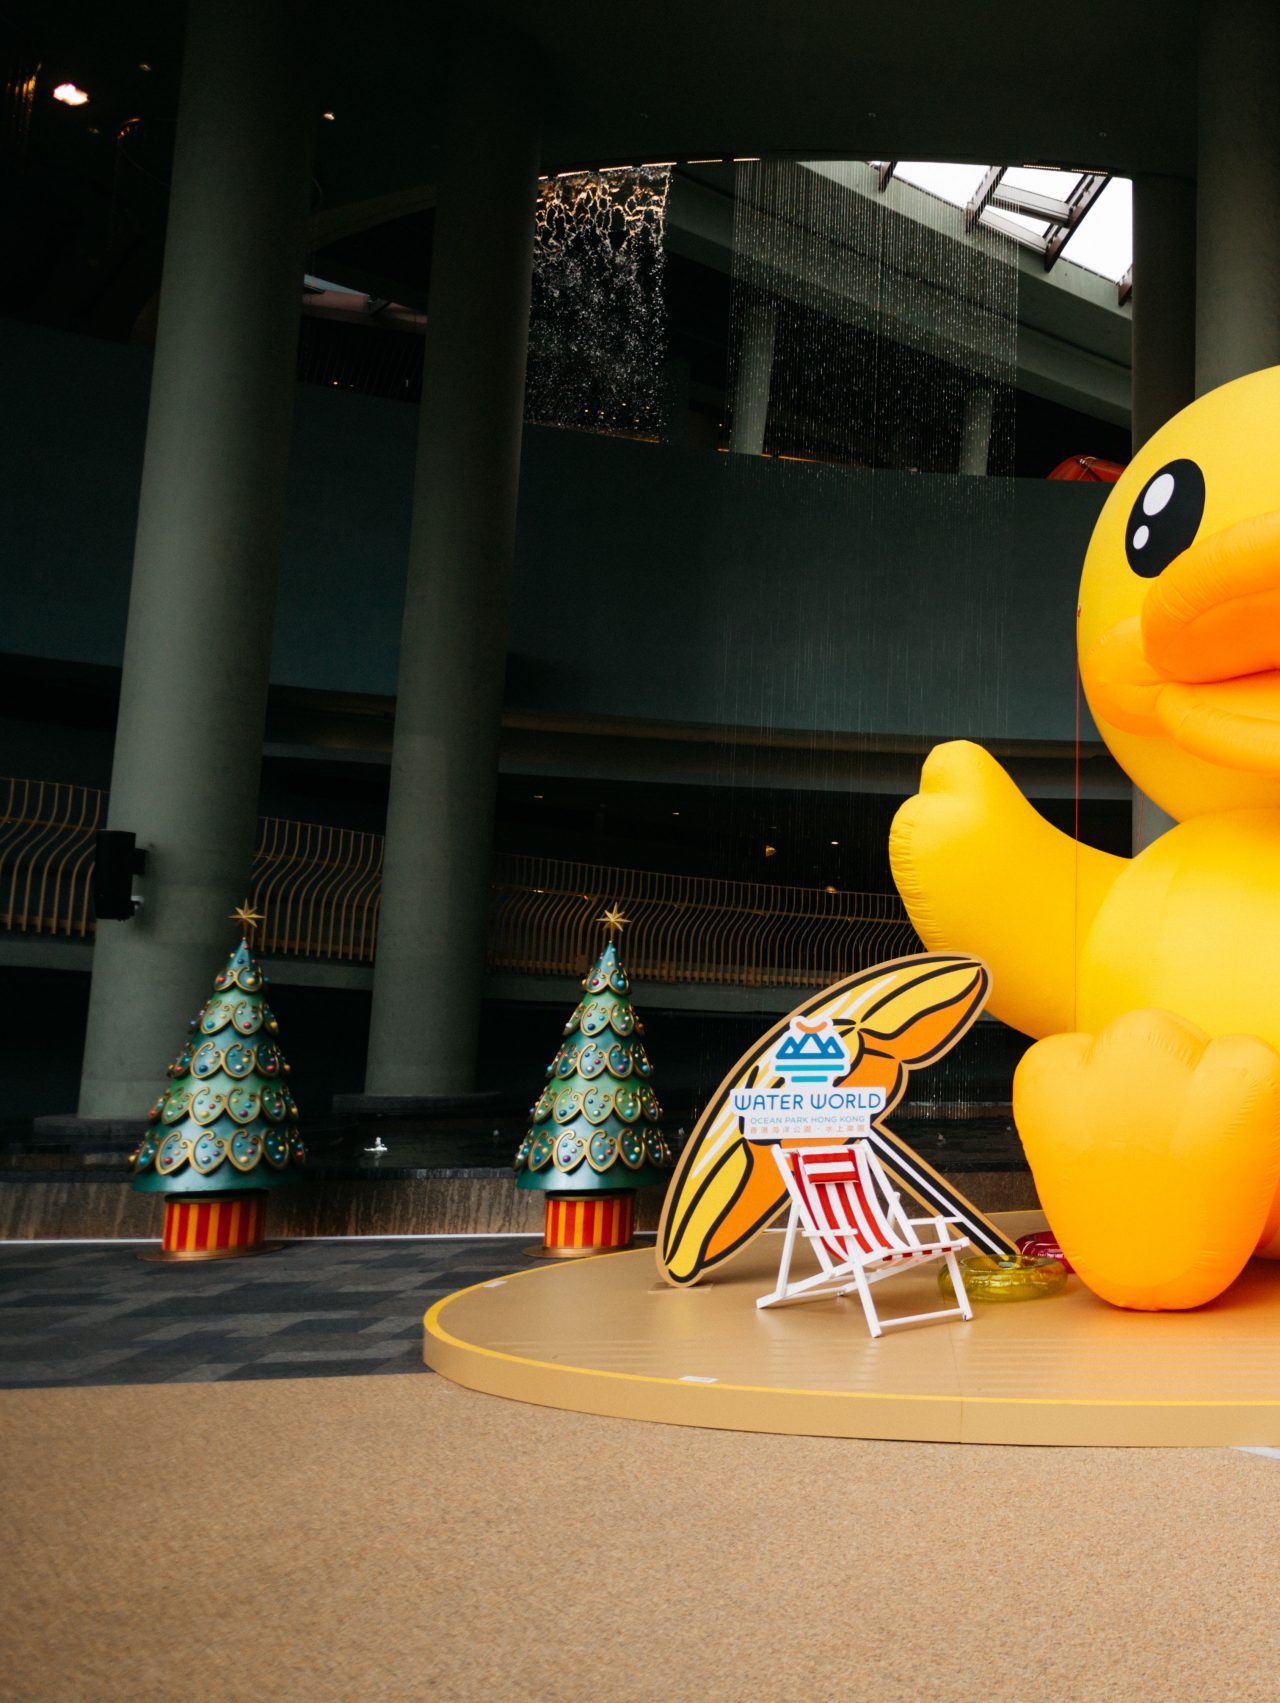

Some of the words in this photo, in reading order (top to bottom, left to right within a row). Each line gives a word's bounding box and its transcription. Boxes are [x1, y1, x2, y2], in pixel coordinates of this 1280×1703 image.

[734, 1094, 804, 1111] WATER
[811, 1093, 882, 1109] WORLD
[750, 1116, 783, 1125] OCEAN
[785, 1115, 808, 1124] PARK
[811, 1114, 838, 1123] HONG
[840, 1113, 865, 1122] KONG
